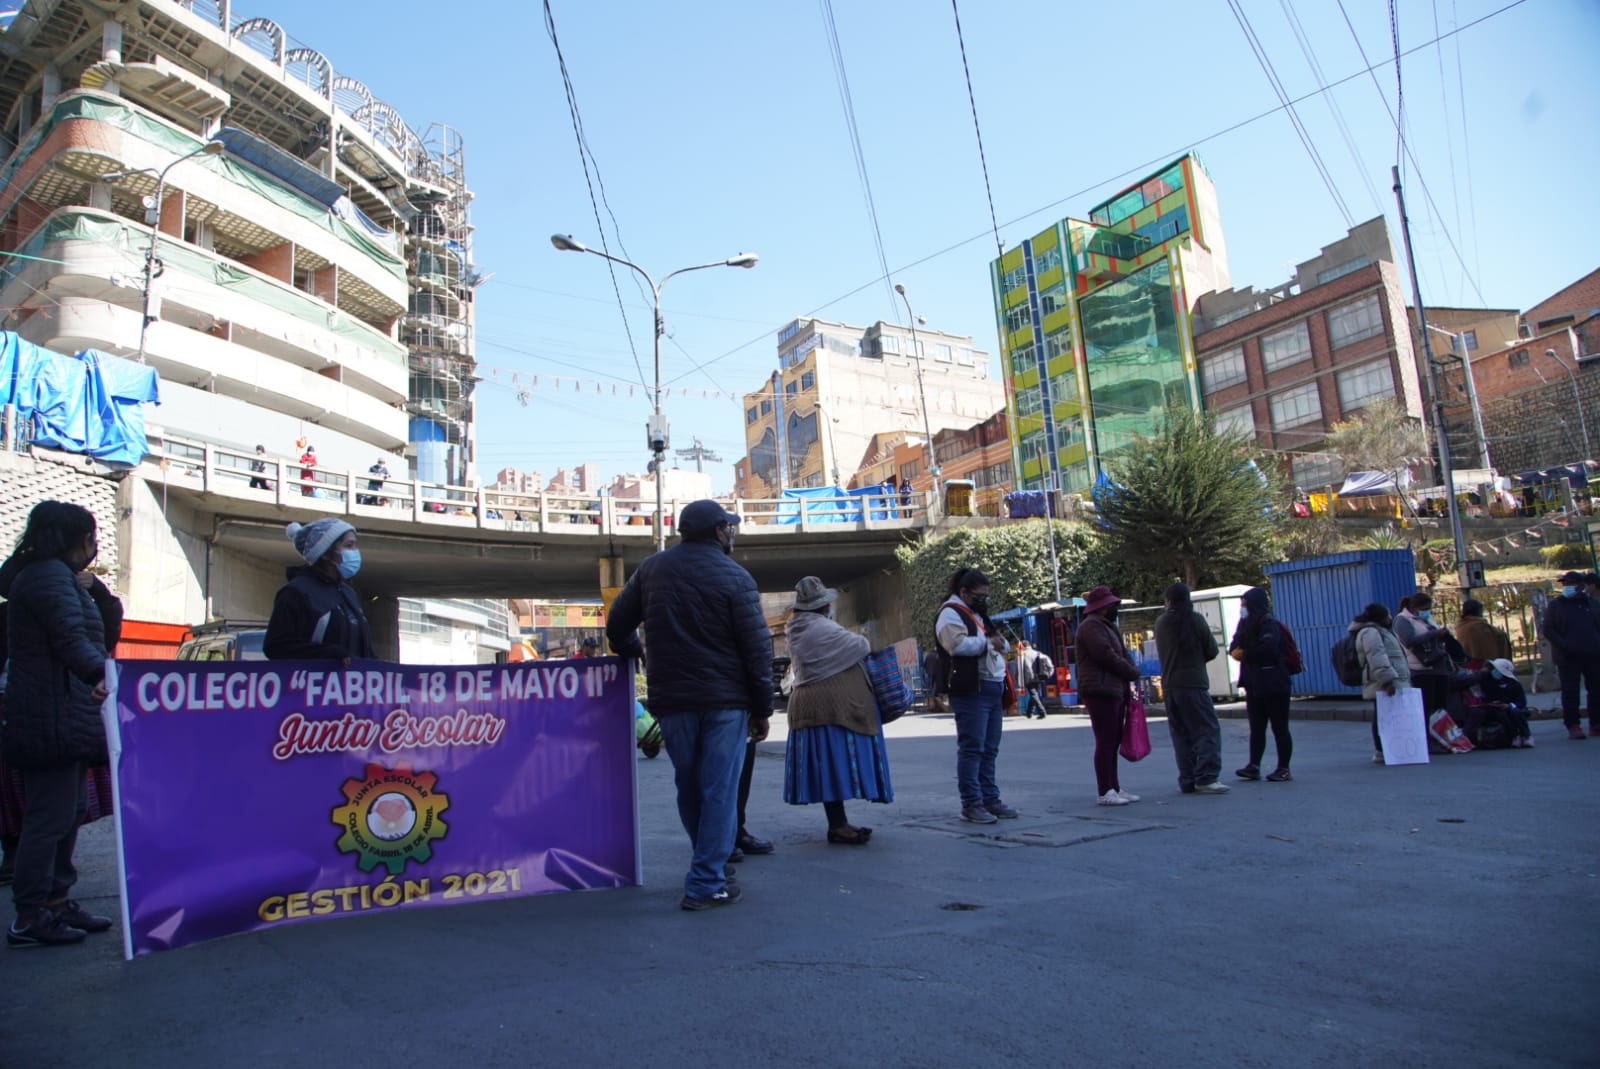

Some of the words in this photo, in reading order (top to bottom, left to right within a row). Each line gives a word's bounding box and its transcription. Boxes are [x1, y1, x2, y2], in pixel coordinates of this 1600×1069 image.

[138, 671, 281, 711] COLEGIO
[290, 670, 410, 706] “FABRIL
[418, 671, 447, 703] 18
[455, 669, 493, 701] DE
[501, 666, 579, 700] MAYO
[273, 713, 380, 760] Junta
[380, 709, 505, 753] Escolar
[352, 780, 382, 806] JUNTA
[384, 775, 428, 798] ESCOLAR
[349, 812, 369, 849] COLEGIO
[368, 846, 401, 857] FABRIL
[423, 806, 434, 834] ABRIL
[258, 875, 430, 922] GESTIÓN
[441, 868, 521, 899] 2021
